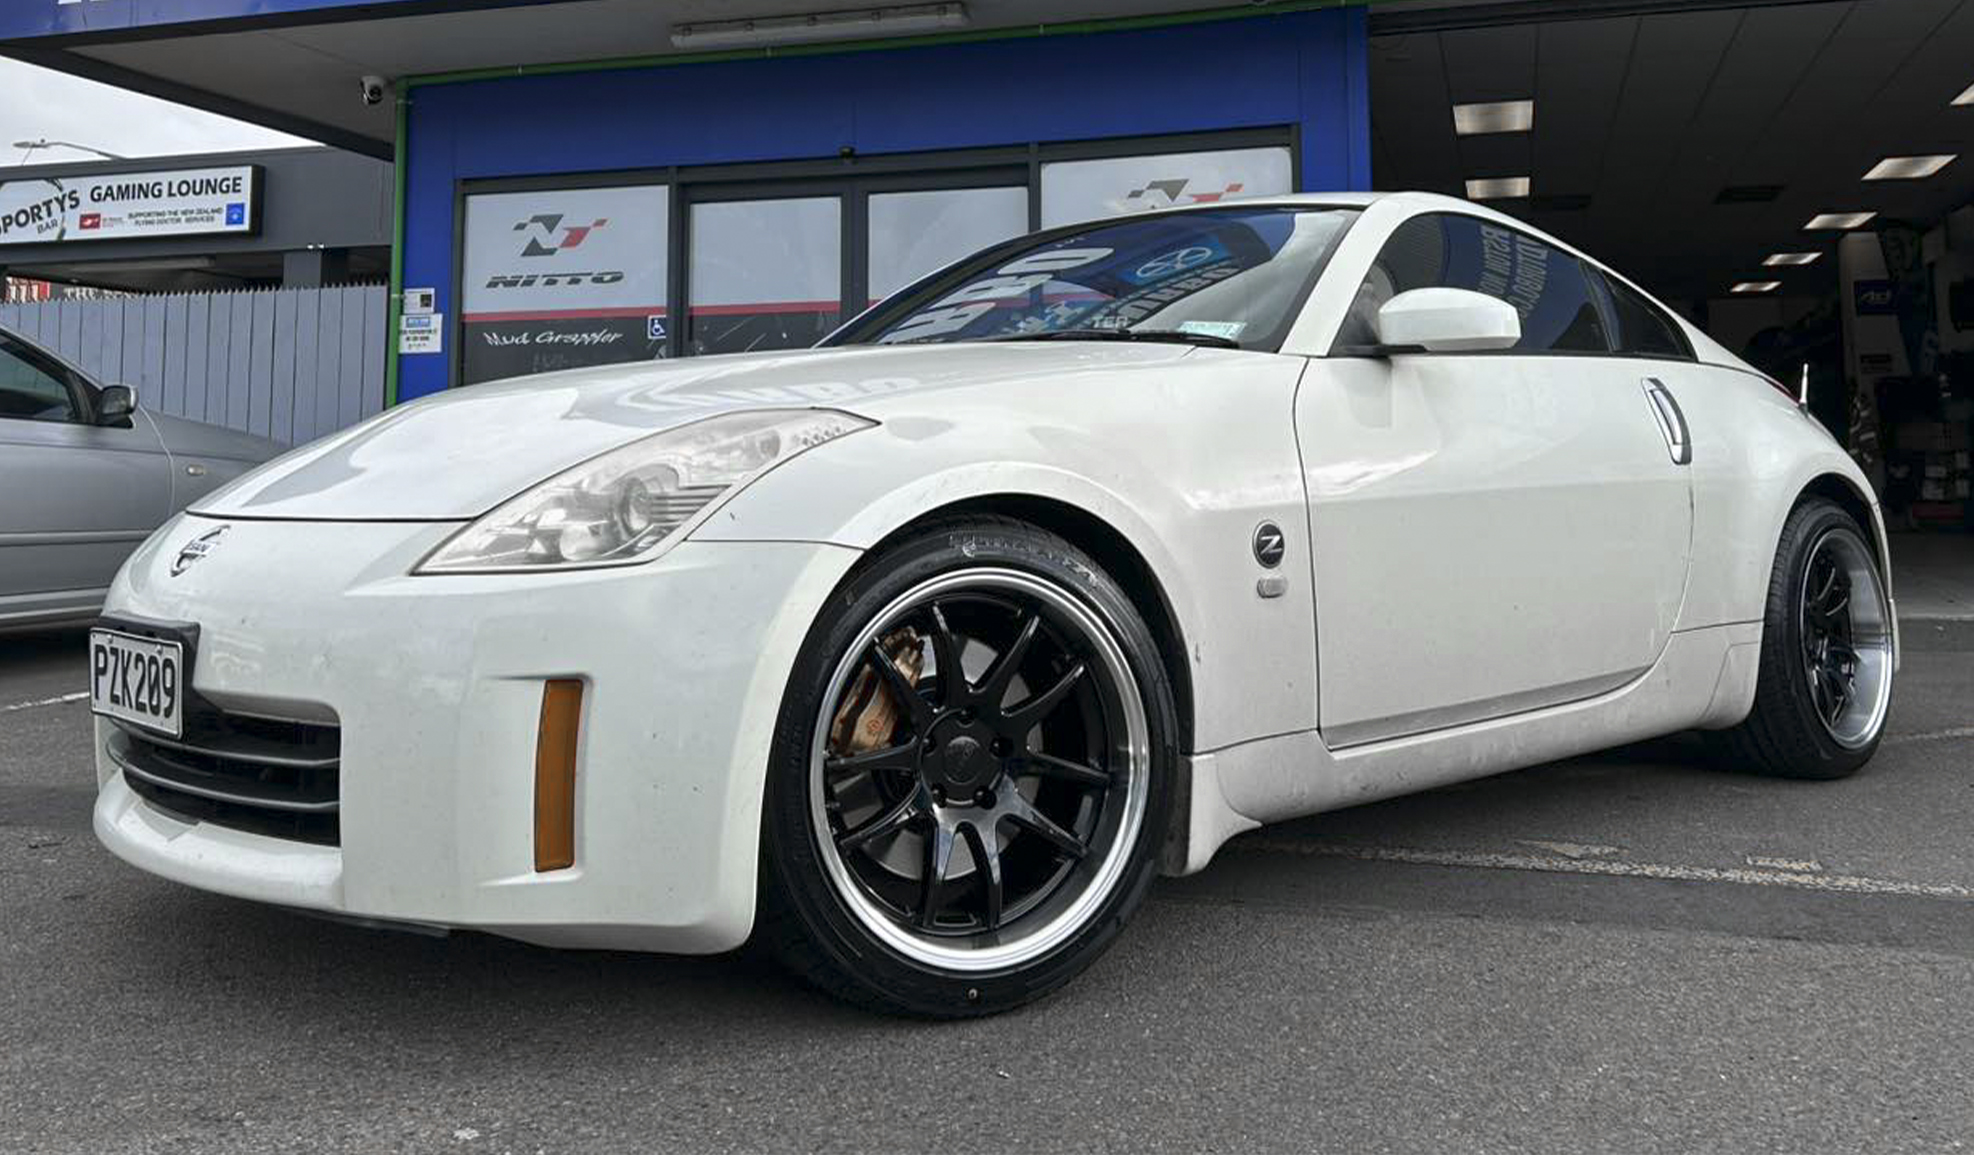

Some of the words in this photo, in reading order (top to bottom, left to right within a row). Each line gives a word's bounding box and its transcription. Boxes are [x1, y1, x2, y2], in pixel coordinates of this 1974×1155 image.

[90, 181, 163, 203] GAMING
[167, 176, 243, 198] LOUNGE
[0, 190, 80, 234] PORTYS
[37, 218, 58, 235] BAR
[485, 270, 625, 289] NITTO
[483, 331, 531, 346] Mud
[534, 328, 624, 347] Grappler
[94, 643, 177, 719] PZK209
